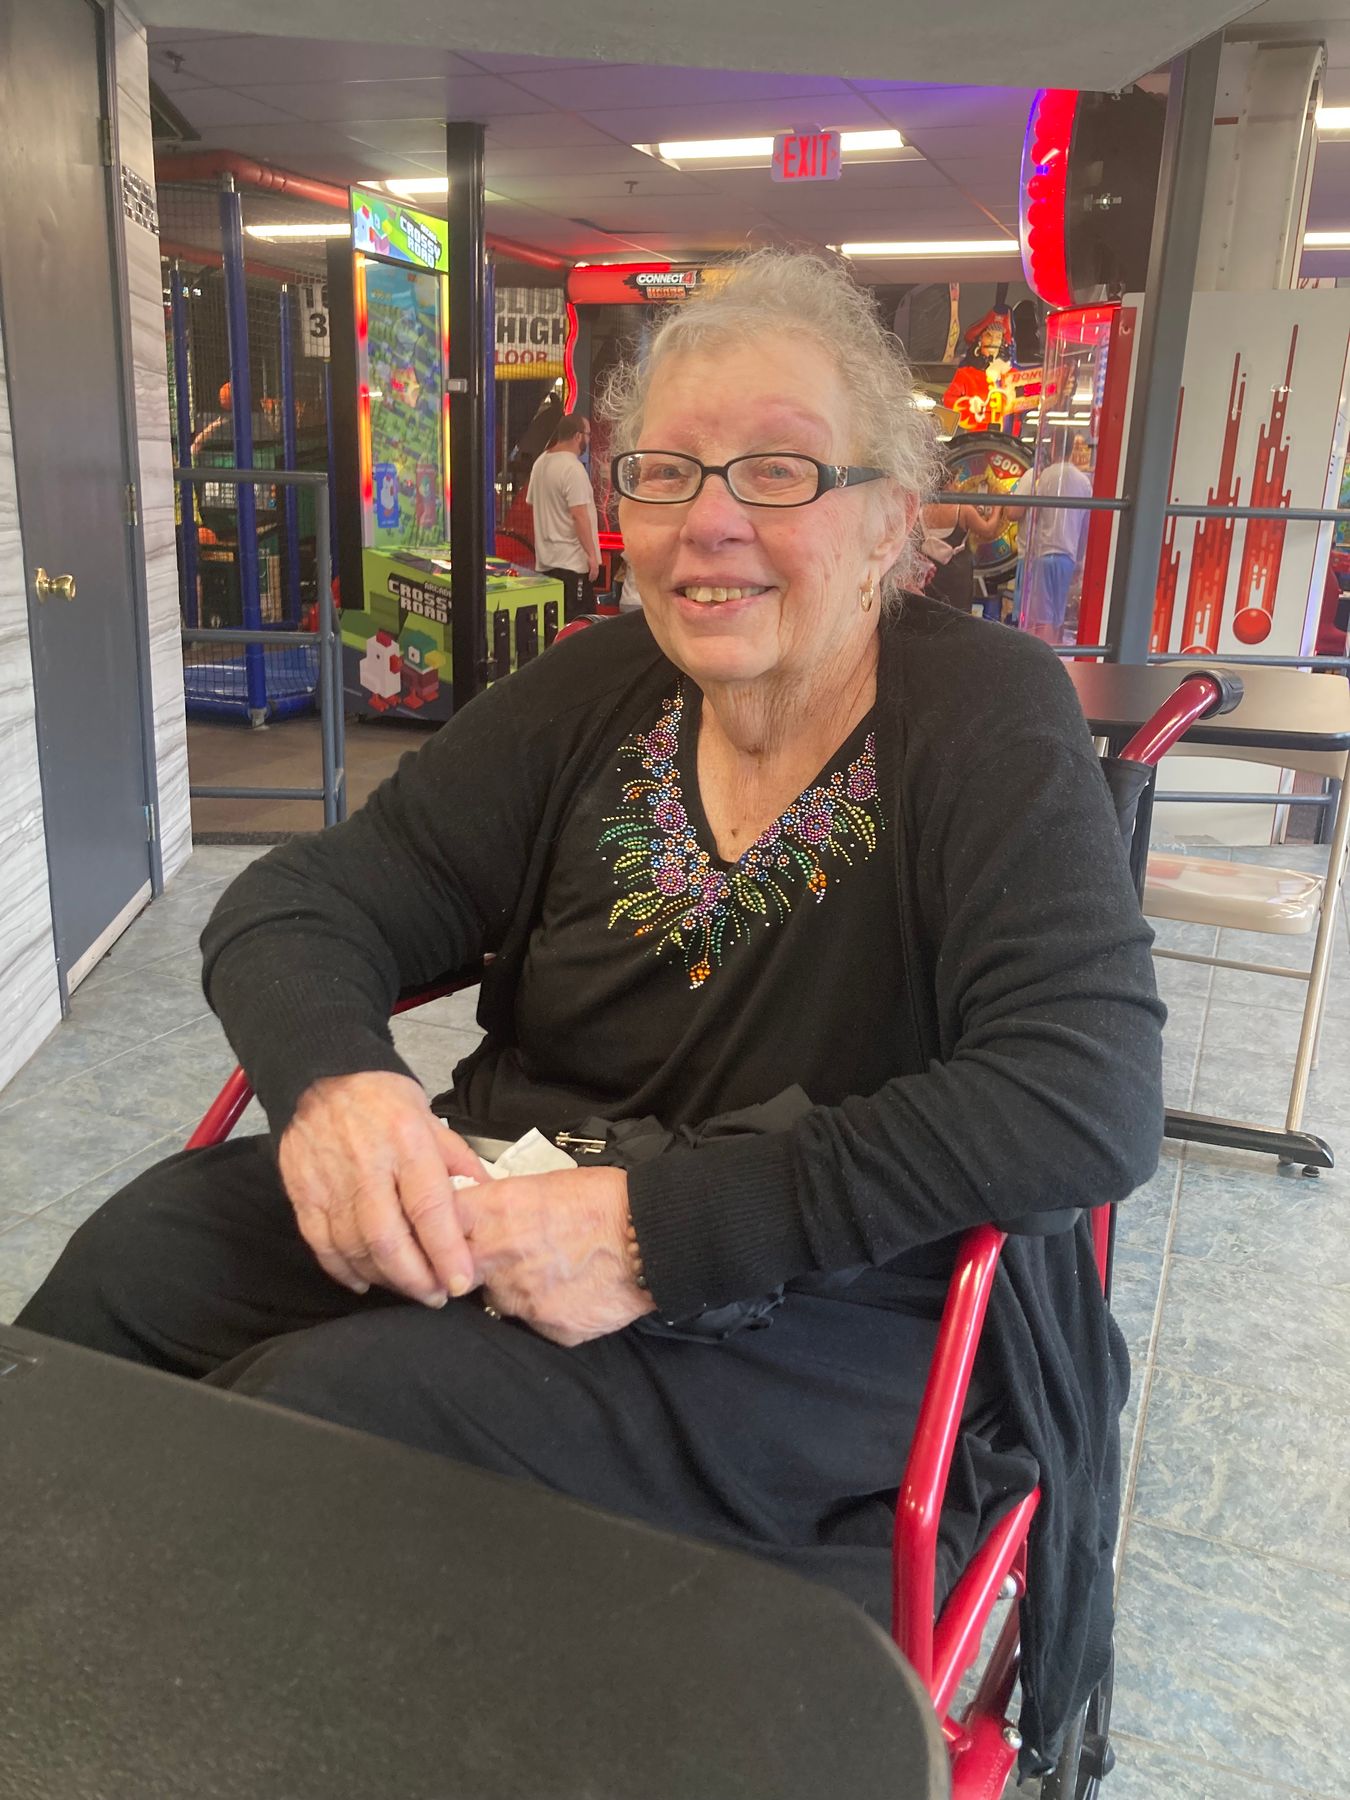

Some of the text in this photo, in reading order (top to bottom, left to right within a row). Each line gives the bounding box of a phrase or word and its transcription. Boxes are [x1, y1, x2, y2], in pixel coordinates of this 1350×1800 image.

[783, 133, 832, 179] EXIT
[400, 215, 441, 261] CROSSY
[407, 235, 435, 269] ROAD
[638, 271, 695, 286] CONNECT 4
[495, 288, 566, 314] SLID
[309, 313, 328, 338] 3
[496, 316, 567, 345] HIGH
[992, 454, 1019, 475] 500
[388, 579, 452, 611] CROSS
[400, 596, 448, 624] ROAD
